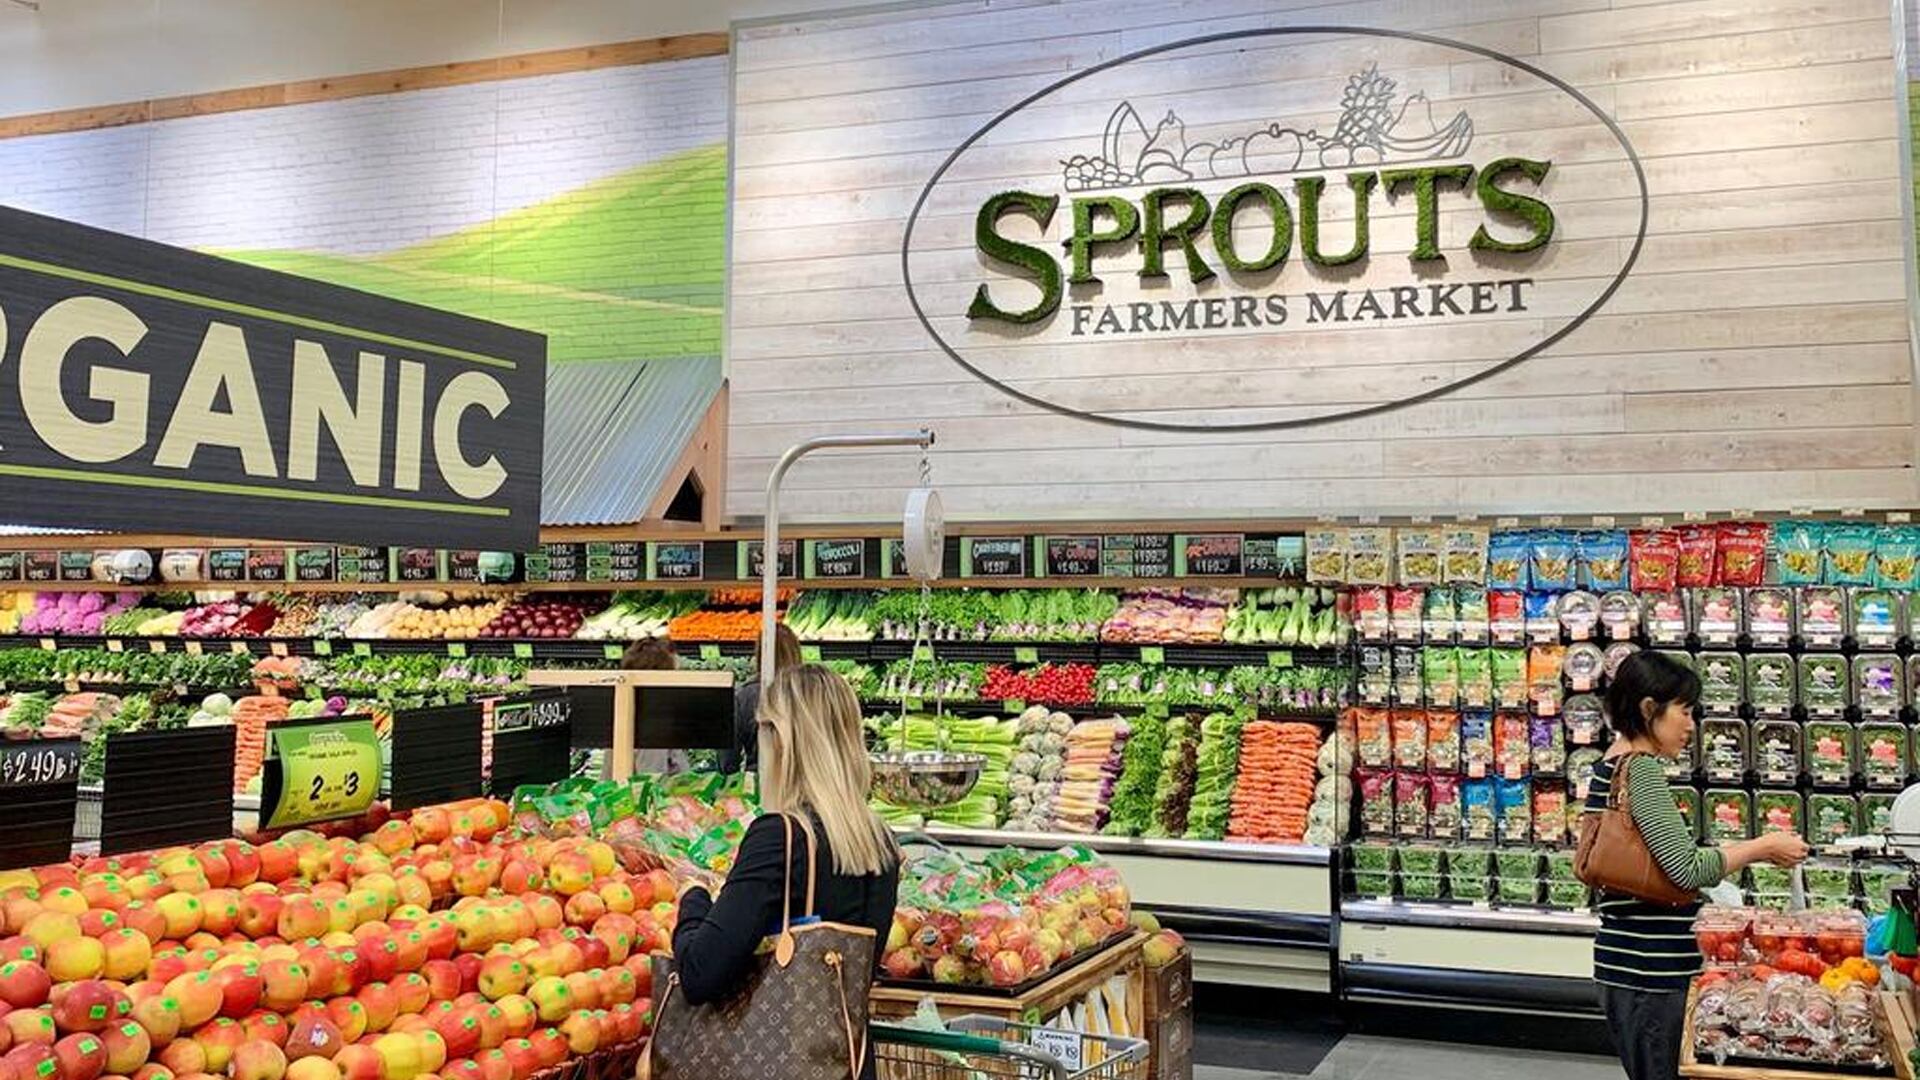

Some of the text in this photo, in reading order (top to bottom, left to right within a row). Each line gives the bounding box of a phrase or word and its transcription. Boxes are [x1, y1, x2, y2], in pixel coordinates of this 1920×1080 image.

[966, 157, 1555, 324] SPROUTS
[1071, 278, 1533, 336] FARMERS MARKET
[0, 296, 511, 499] GANIC
[309, 775, 324, 801] 2
